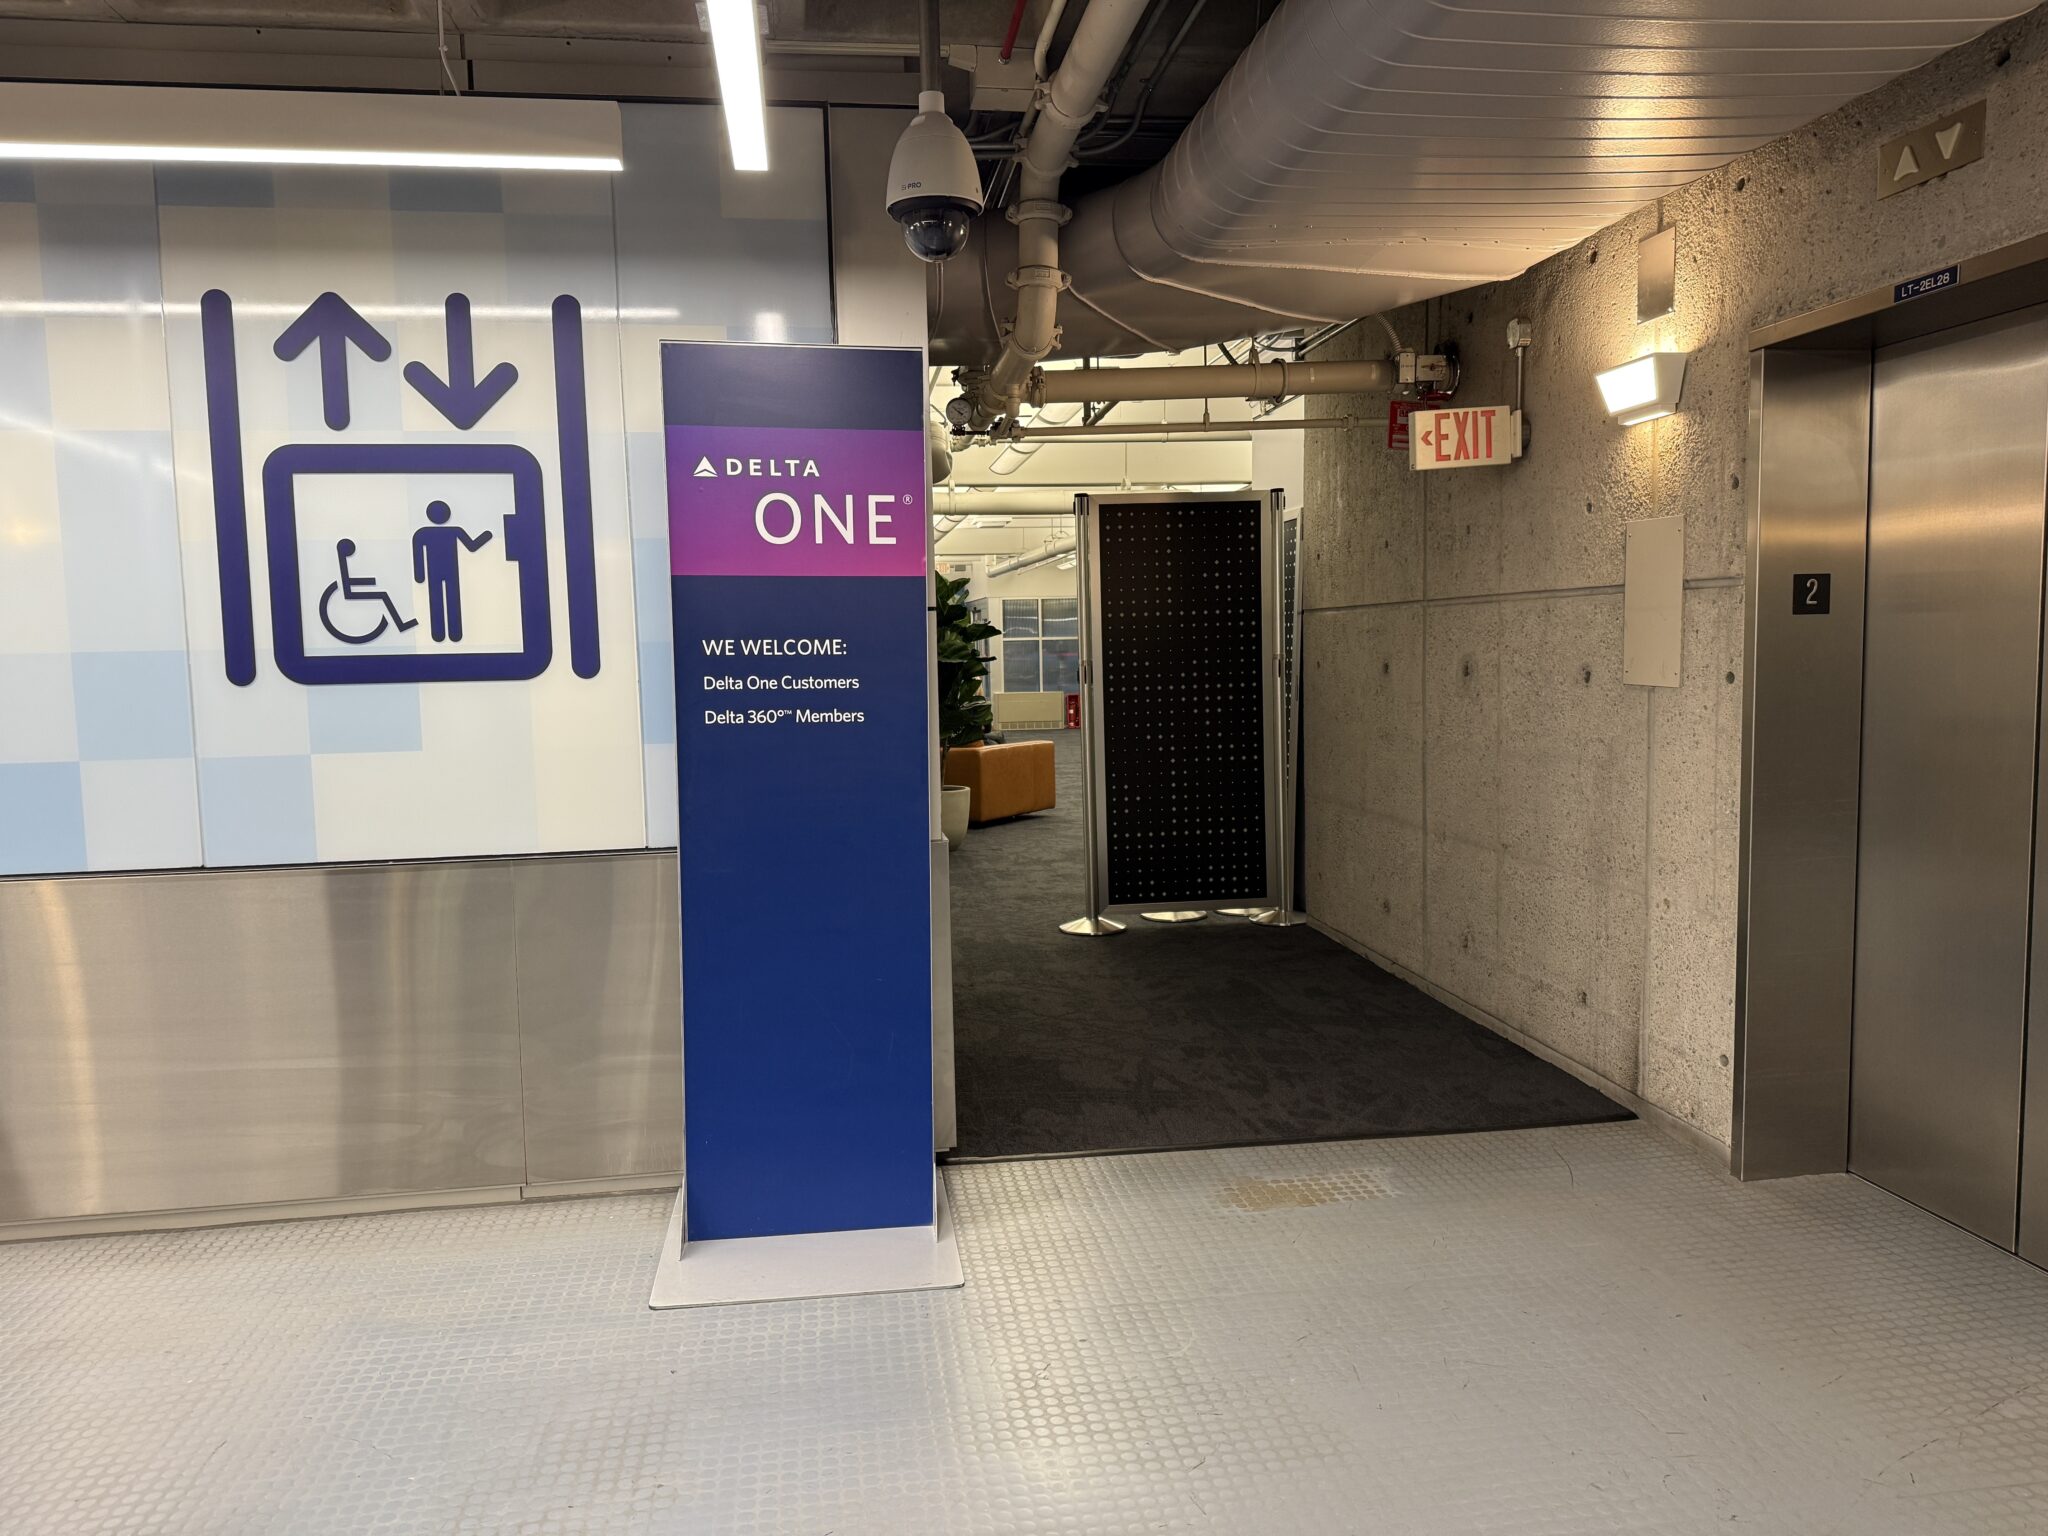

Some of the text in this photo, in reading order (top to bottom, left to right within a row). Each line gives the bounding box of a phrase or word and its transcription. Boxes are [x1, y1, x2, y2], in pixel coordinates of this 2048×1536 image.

[1901, 272, 1950, 297] LT-2EL28
[1434, 409, 1496, 462] EXIT
[726, 458, 820, 477] DELTA
[1806, 578, 1818, 605] 2
[702, 639, 847, 656] WE WELCOME:
[703, 675, 860, 690] Delta One Customers
[705, 710, 744, 724] Delta
[796, 708, 865, 723] Members
